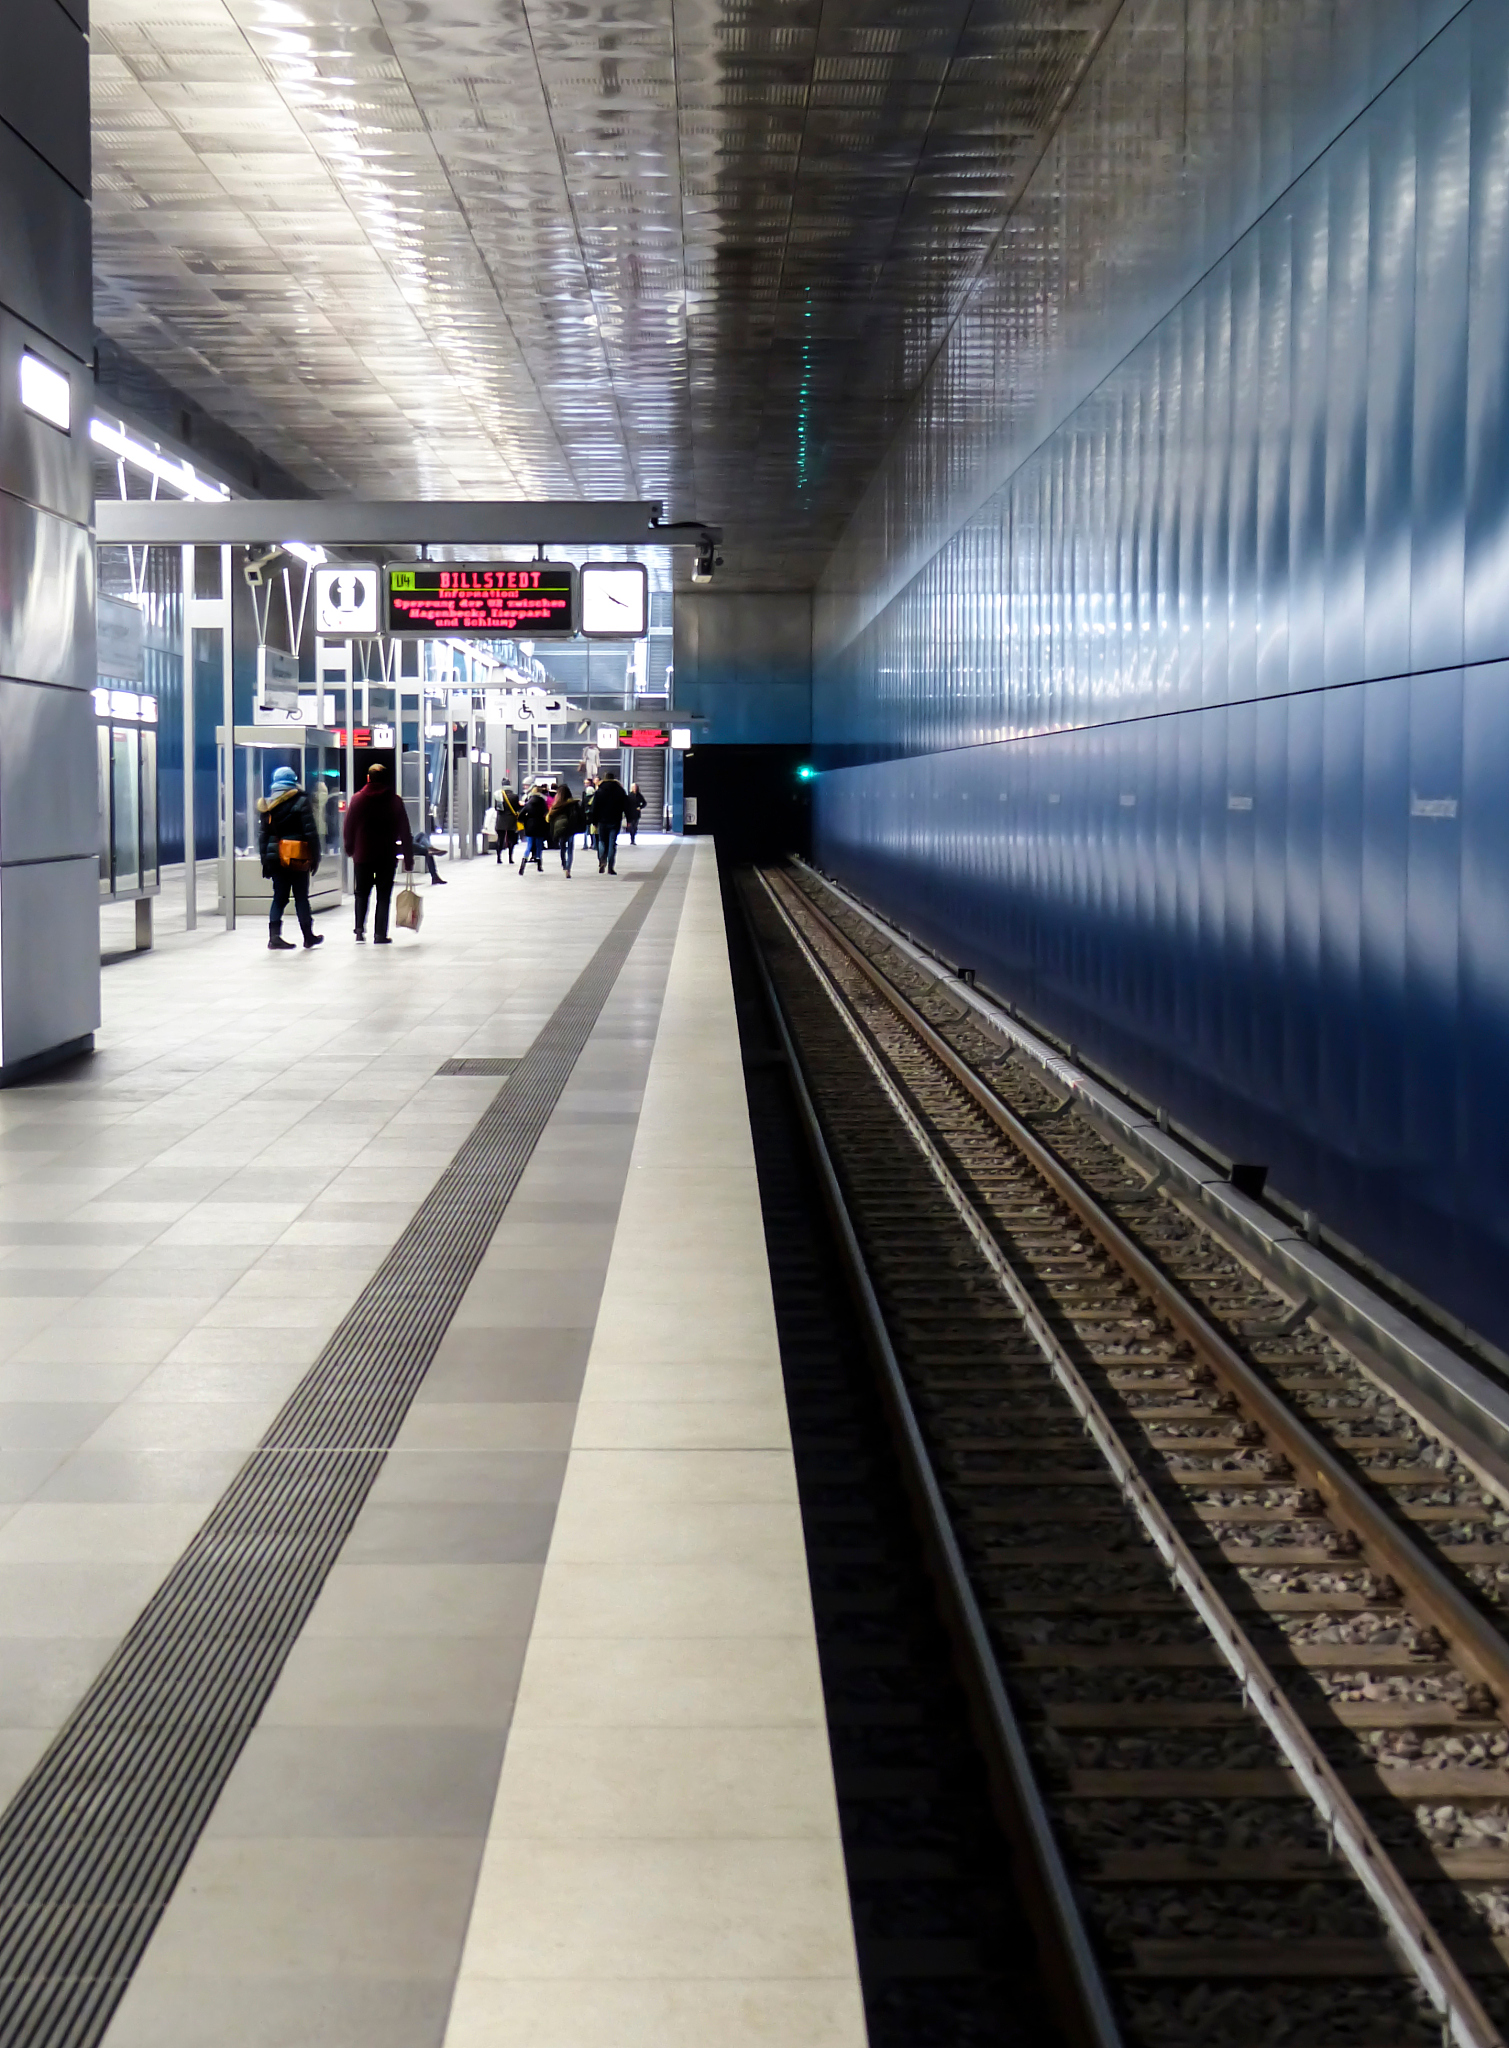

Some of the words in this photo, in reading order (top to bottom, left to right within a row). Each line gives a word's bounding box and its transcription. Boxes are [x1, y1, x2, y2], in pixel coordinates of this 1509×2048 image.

[396, 574, 410, 588] U4
[440, 571, 541, 588] BILLSTEDT
[459, 598, 484, 608] der
[507, 598, 566, 608] zwischen
[435, 618, 459, 627] und
[463, 618, 517, 628] Schlump
